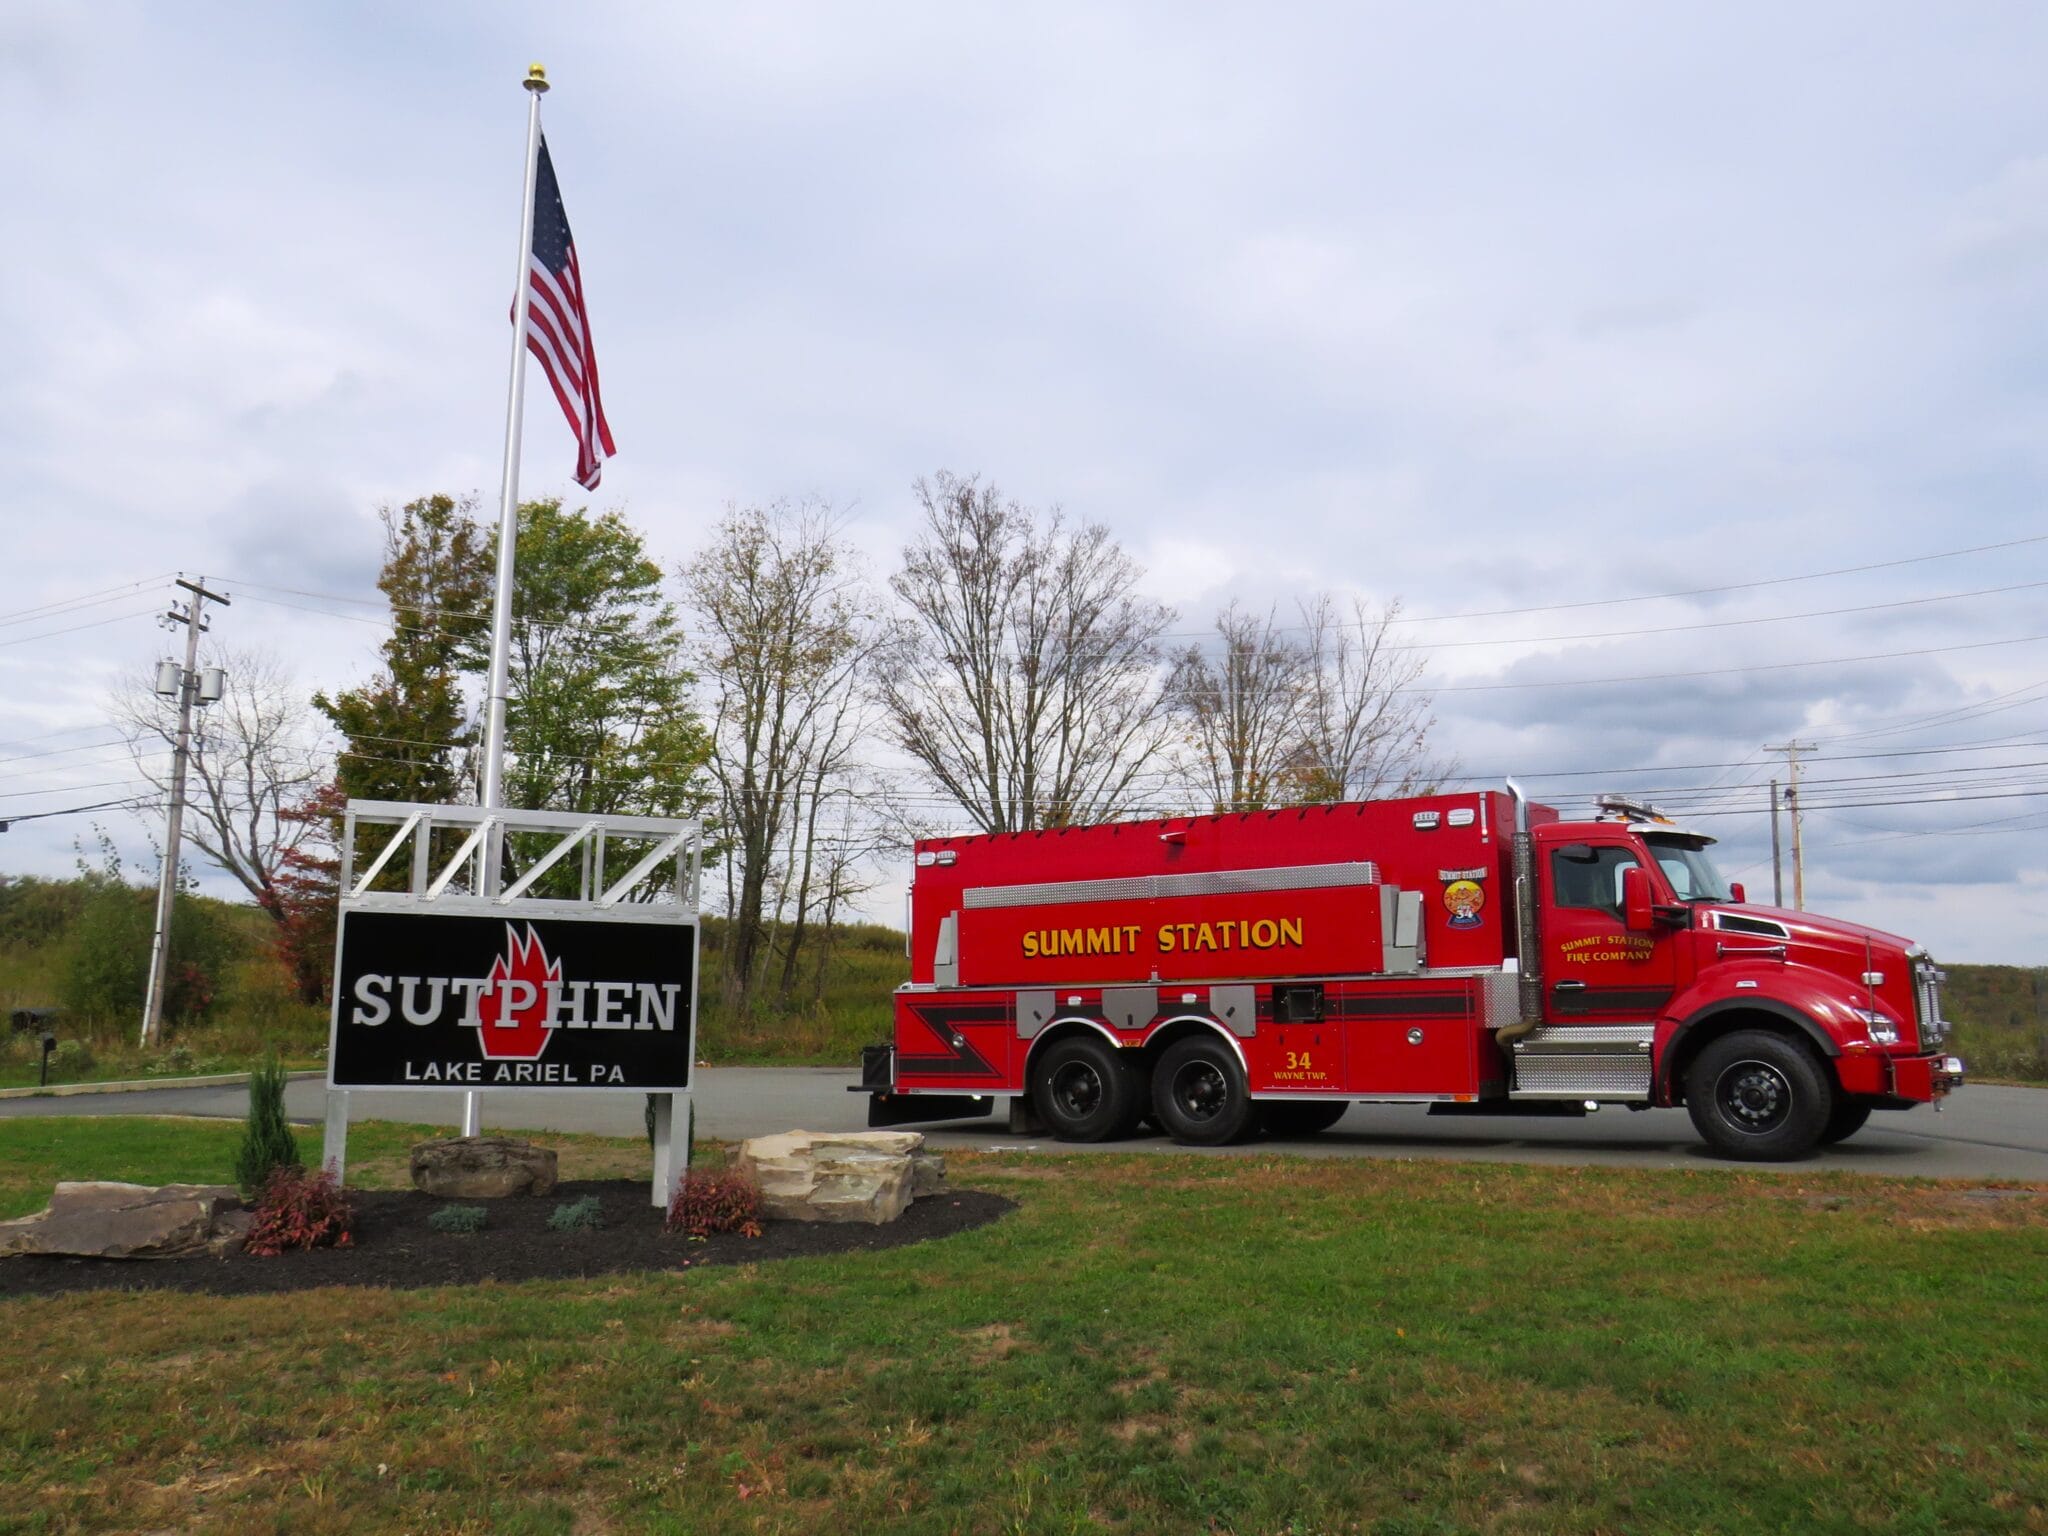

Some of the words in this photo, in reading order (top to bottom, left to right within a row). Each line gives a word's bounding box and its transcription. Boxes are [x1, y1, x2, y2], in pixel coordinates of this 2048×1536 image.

[1022, 925, 1141, 957] SUMMIT
[1158, 918, 1303, 951] STATION
[1560, 936, 1601, 953] SUMMIT
[1607, 935, 1655, 949] STATION
[1566, 952, 1591, 964] FIRE
[1593, 951, 1651, 961] COMPANY
[352, 973, 681, 1031] SUTPHEN
[1286, 1051, 1312, 1070] 34
[405, 1062, 482, 1081] LAKE
[494, 1063, 577, 1082] ARIEL
[590, 1064, 625, 1082] PA
[1273, 1071, 1305, 1080] WAYNE
[1306, 1071, 1328, 1080] TWP.
